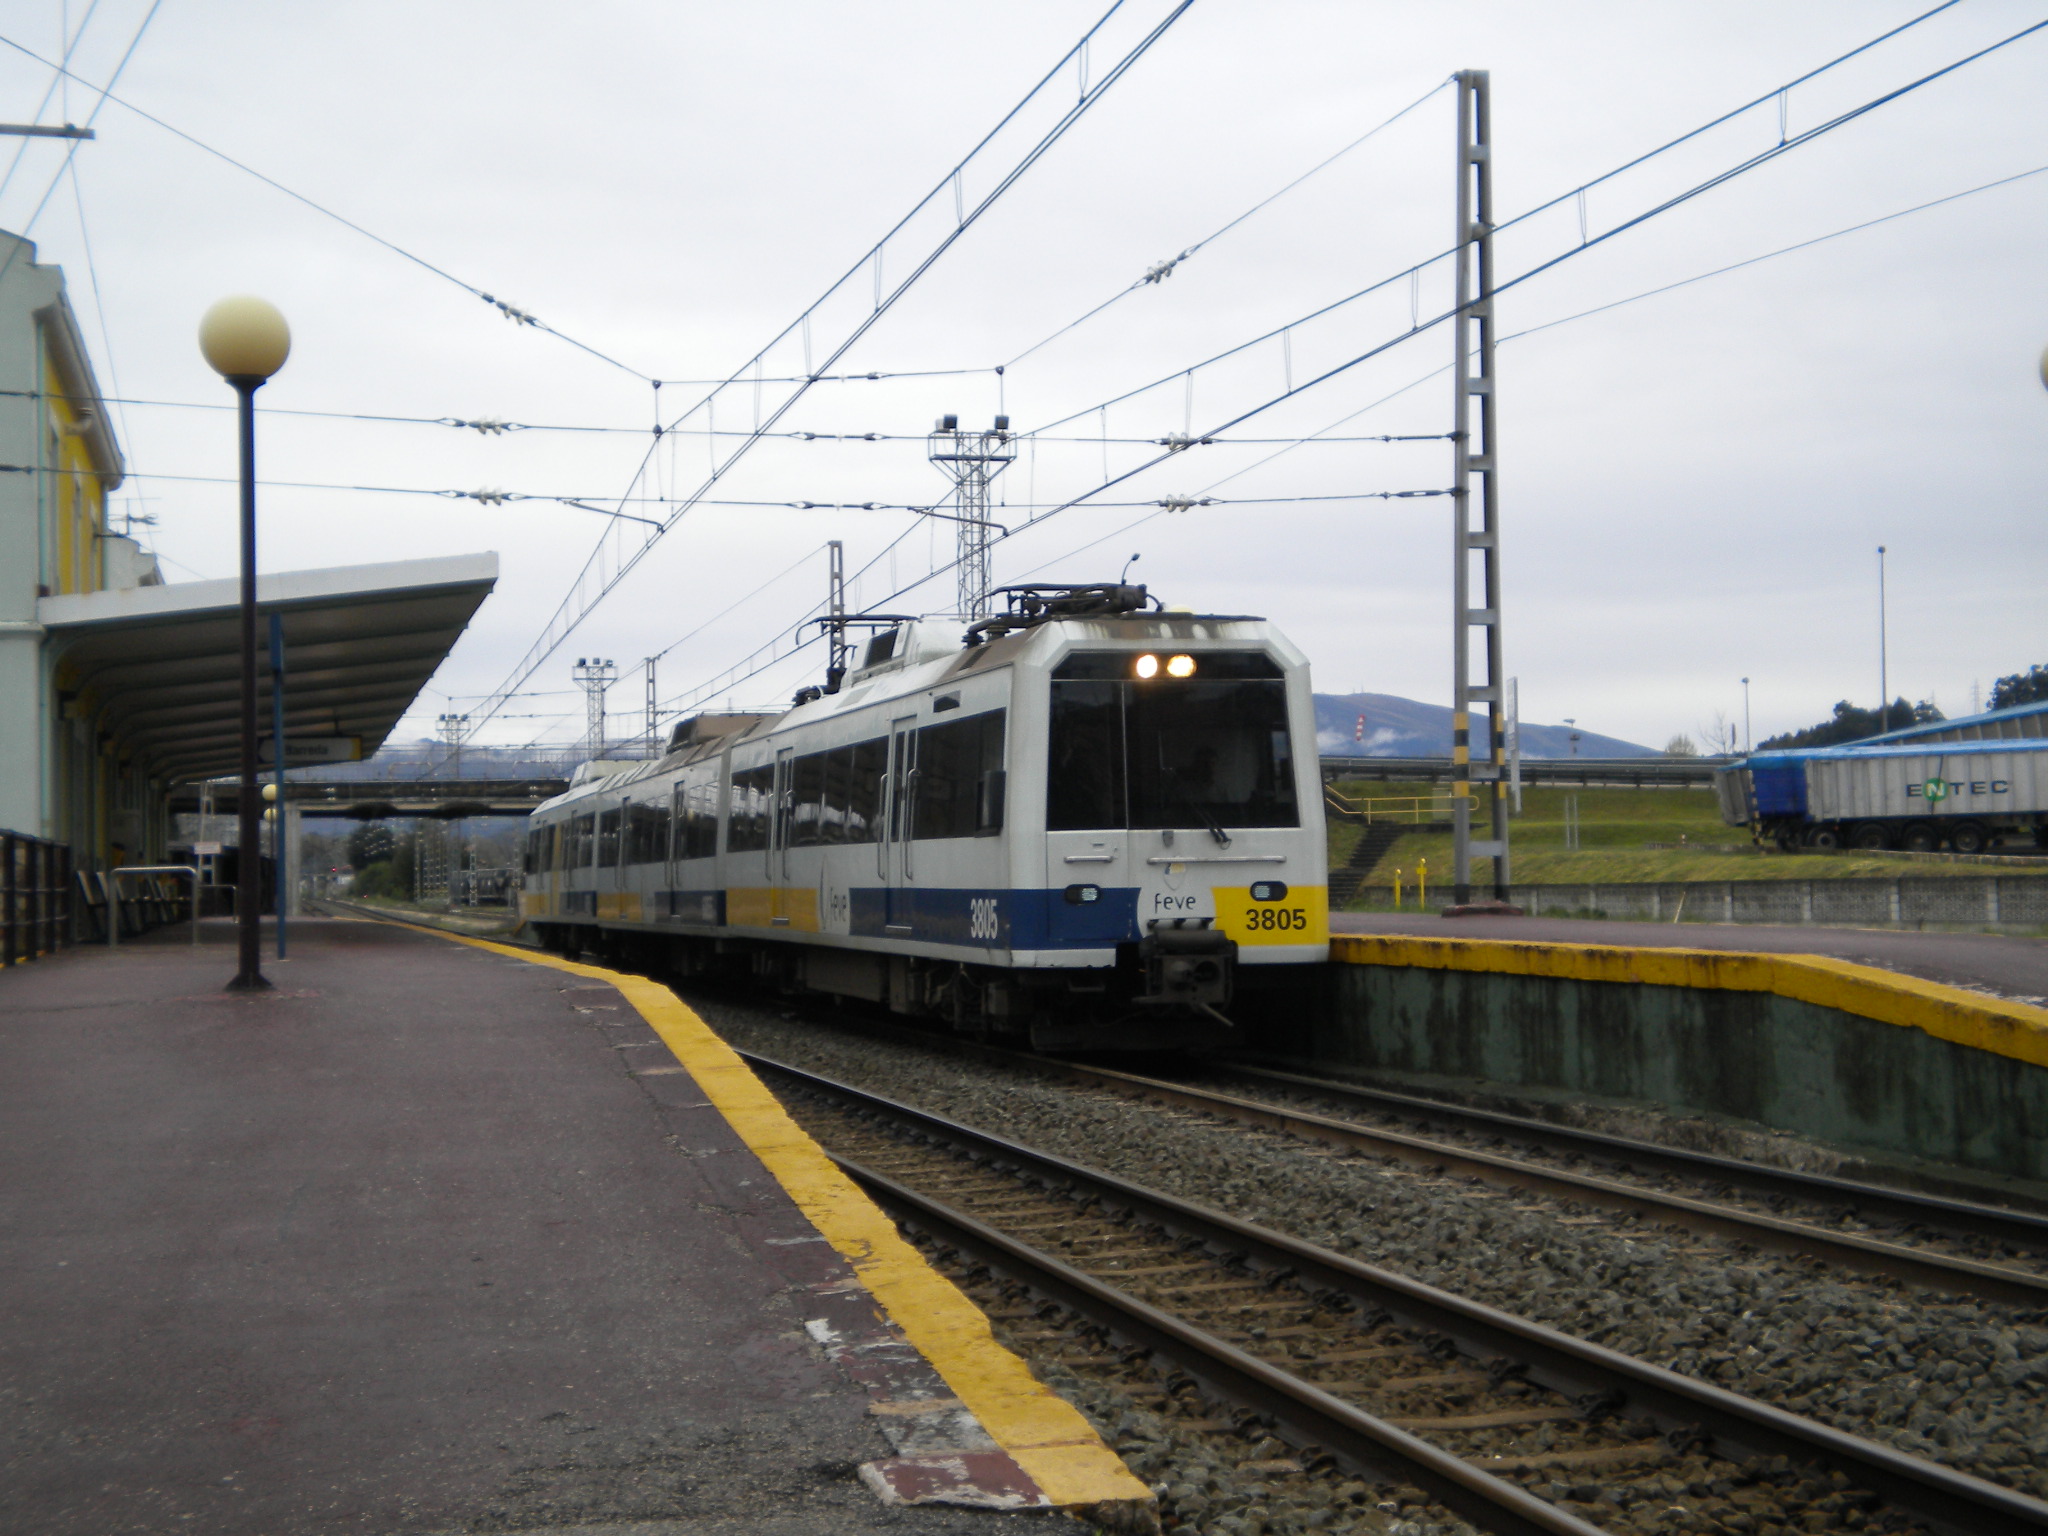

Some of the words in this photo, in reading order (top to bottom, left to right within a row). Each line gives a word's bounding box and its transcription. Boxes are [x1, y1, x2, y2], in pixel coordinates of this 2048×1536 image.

[1905, 780, 2009, 798] ENTEC
[1154, 893, 1197, 914] feve
[970, 898, 998, 939] 3805
[1246, 908, 1307, 931] 3805
